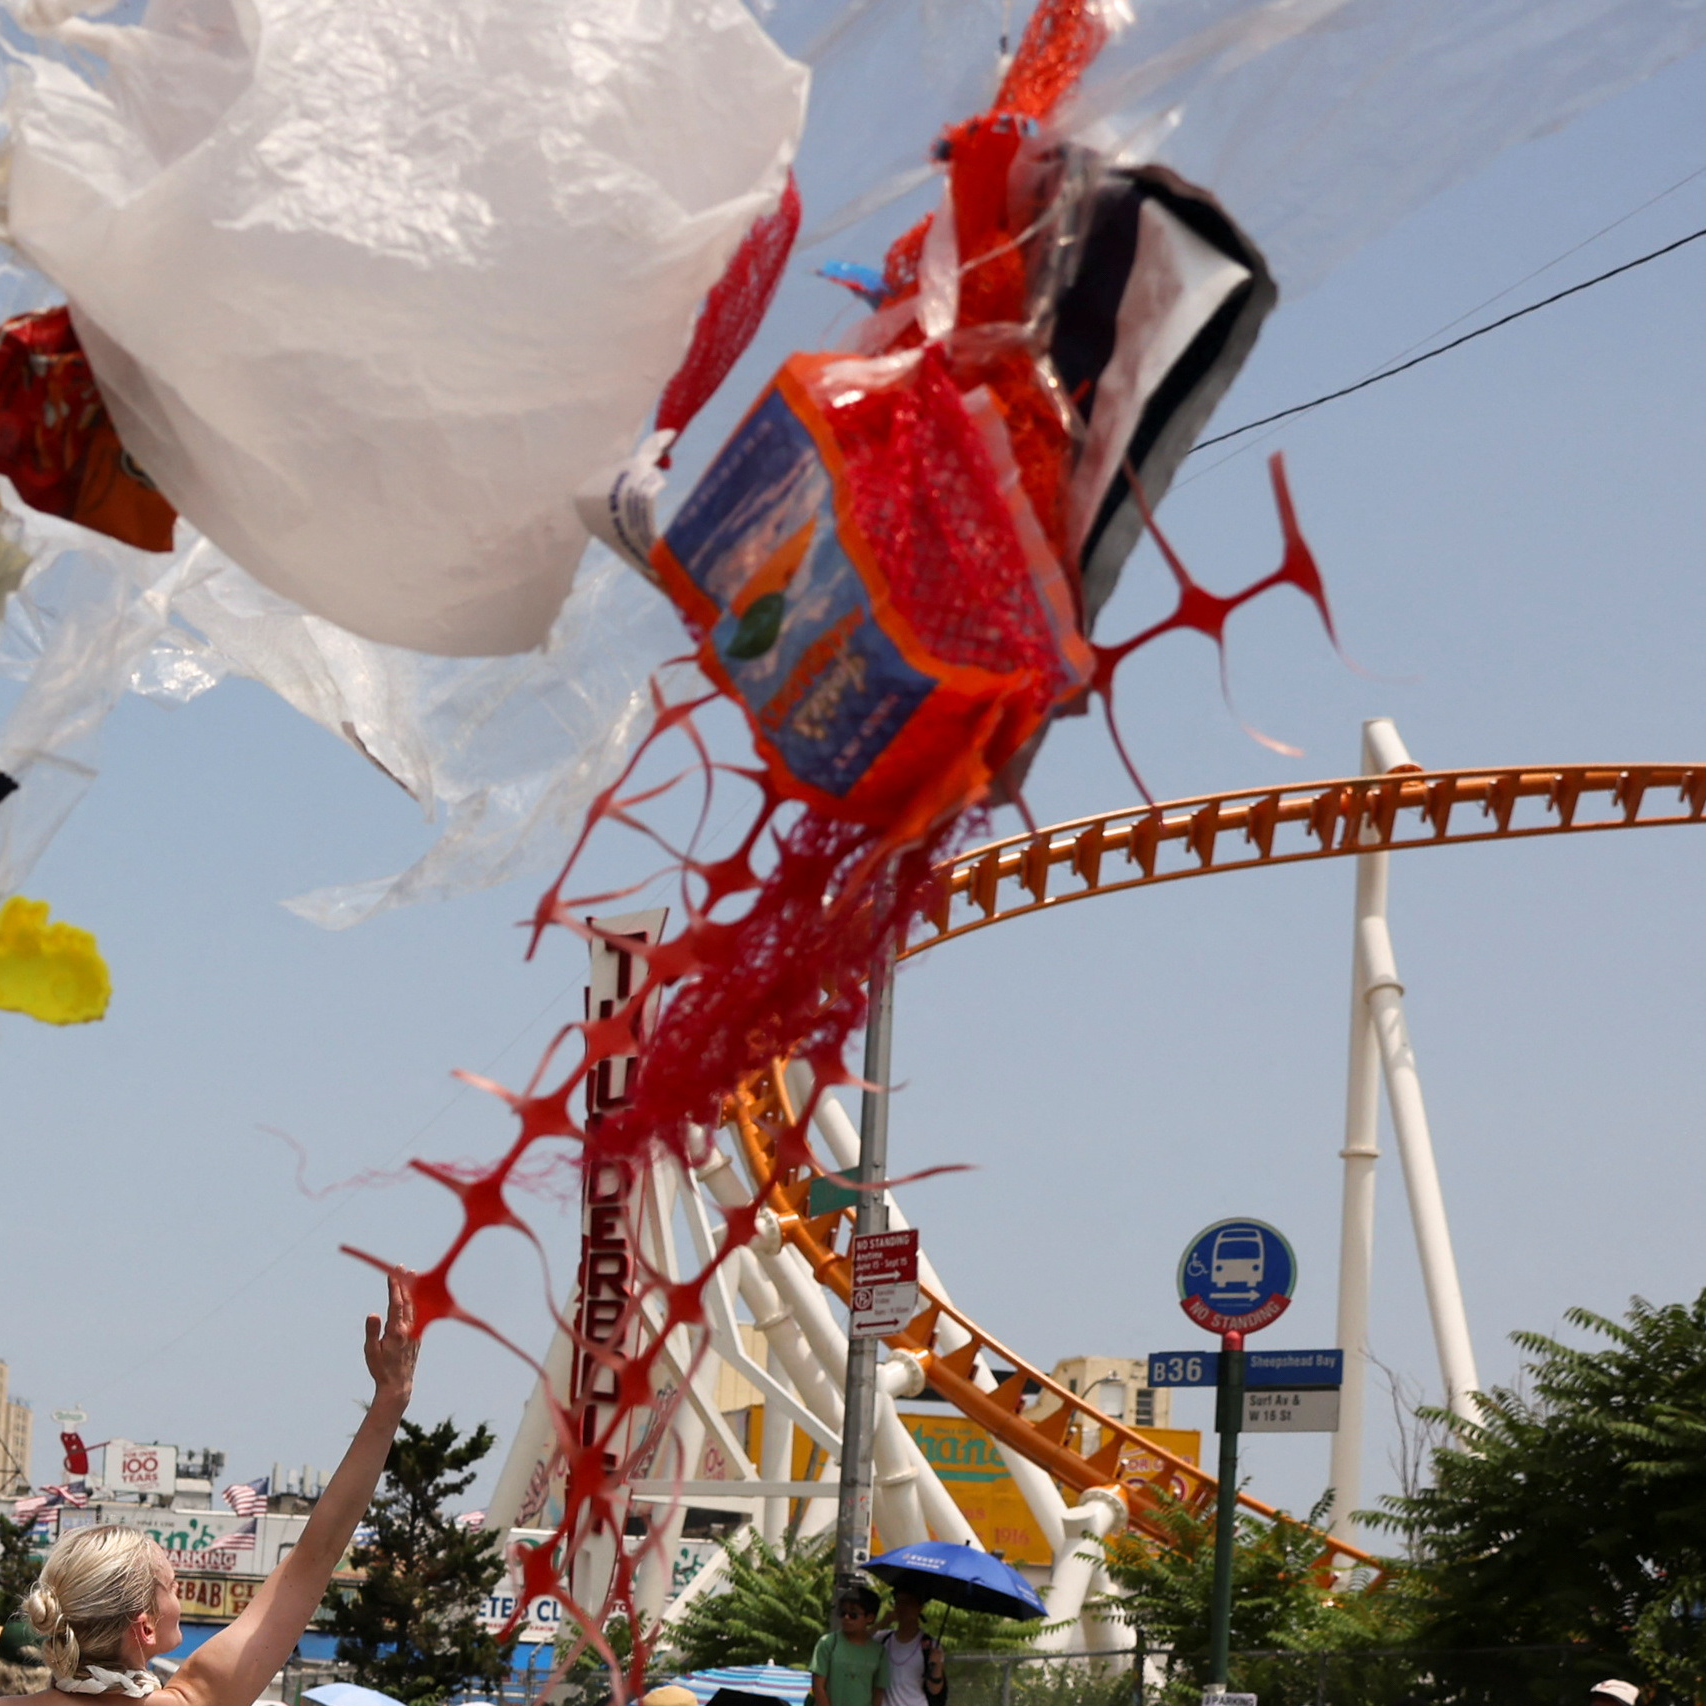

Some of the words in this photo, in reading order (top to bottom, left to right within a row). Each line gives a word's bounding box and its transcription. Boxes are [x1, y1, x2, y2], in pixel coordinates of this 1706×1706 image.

[857, 1240, 869, 1250] NO
[870, 1234, 910, 1250] STANDING
[856, 1252, 883, 1261] Anytime
[856, 1262, 871, 1271] June
[885, 1258, 899, 1268] Sept
[1189, 1301, 1210, 1320] NO
[1211, 1301, 1281, 1329] STANDING
[1250, 1355, 1313, 1369] Sheepshead
[1316, 1354, 1336, 1368] Bay
[1153, 1357, 1202, 1382] B36
[1249, 1394, 1272, 1406] Surf
[1275, 1394, 1288, 1406] Av
[1292, 1394, 1301, 1406] &
[1249, 1410, 1260, 1421] W
[1279, 1410, 1292, 1421] St
[123, 1457, 158, 1473] 100
[122, 1474, 158, 1482] YEARS
[994, 1527, 1031, 1546] 1916
